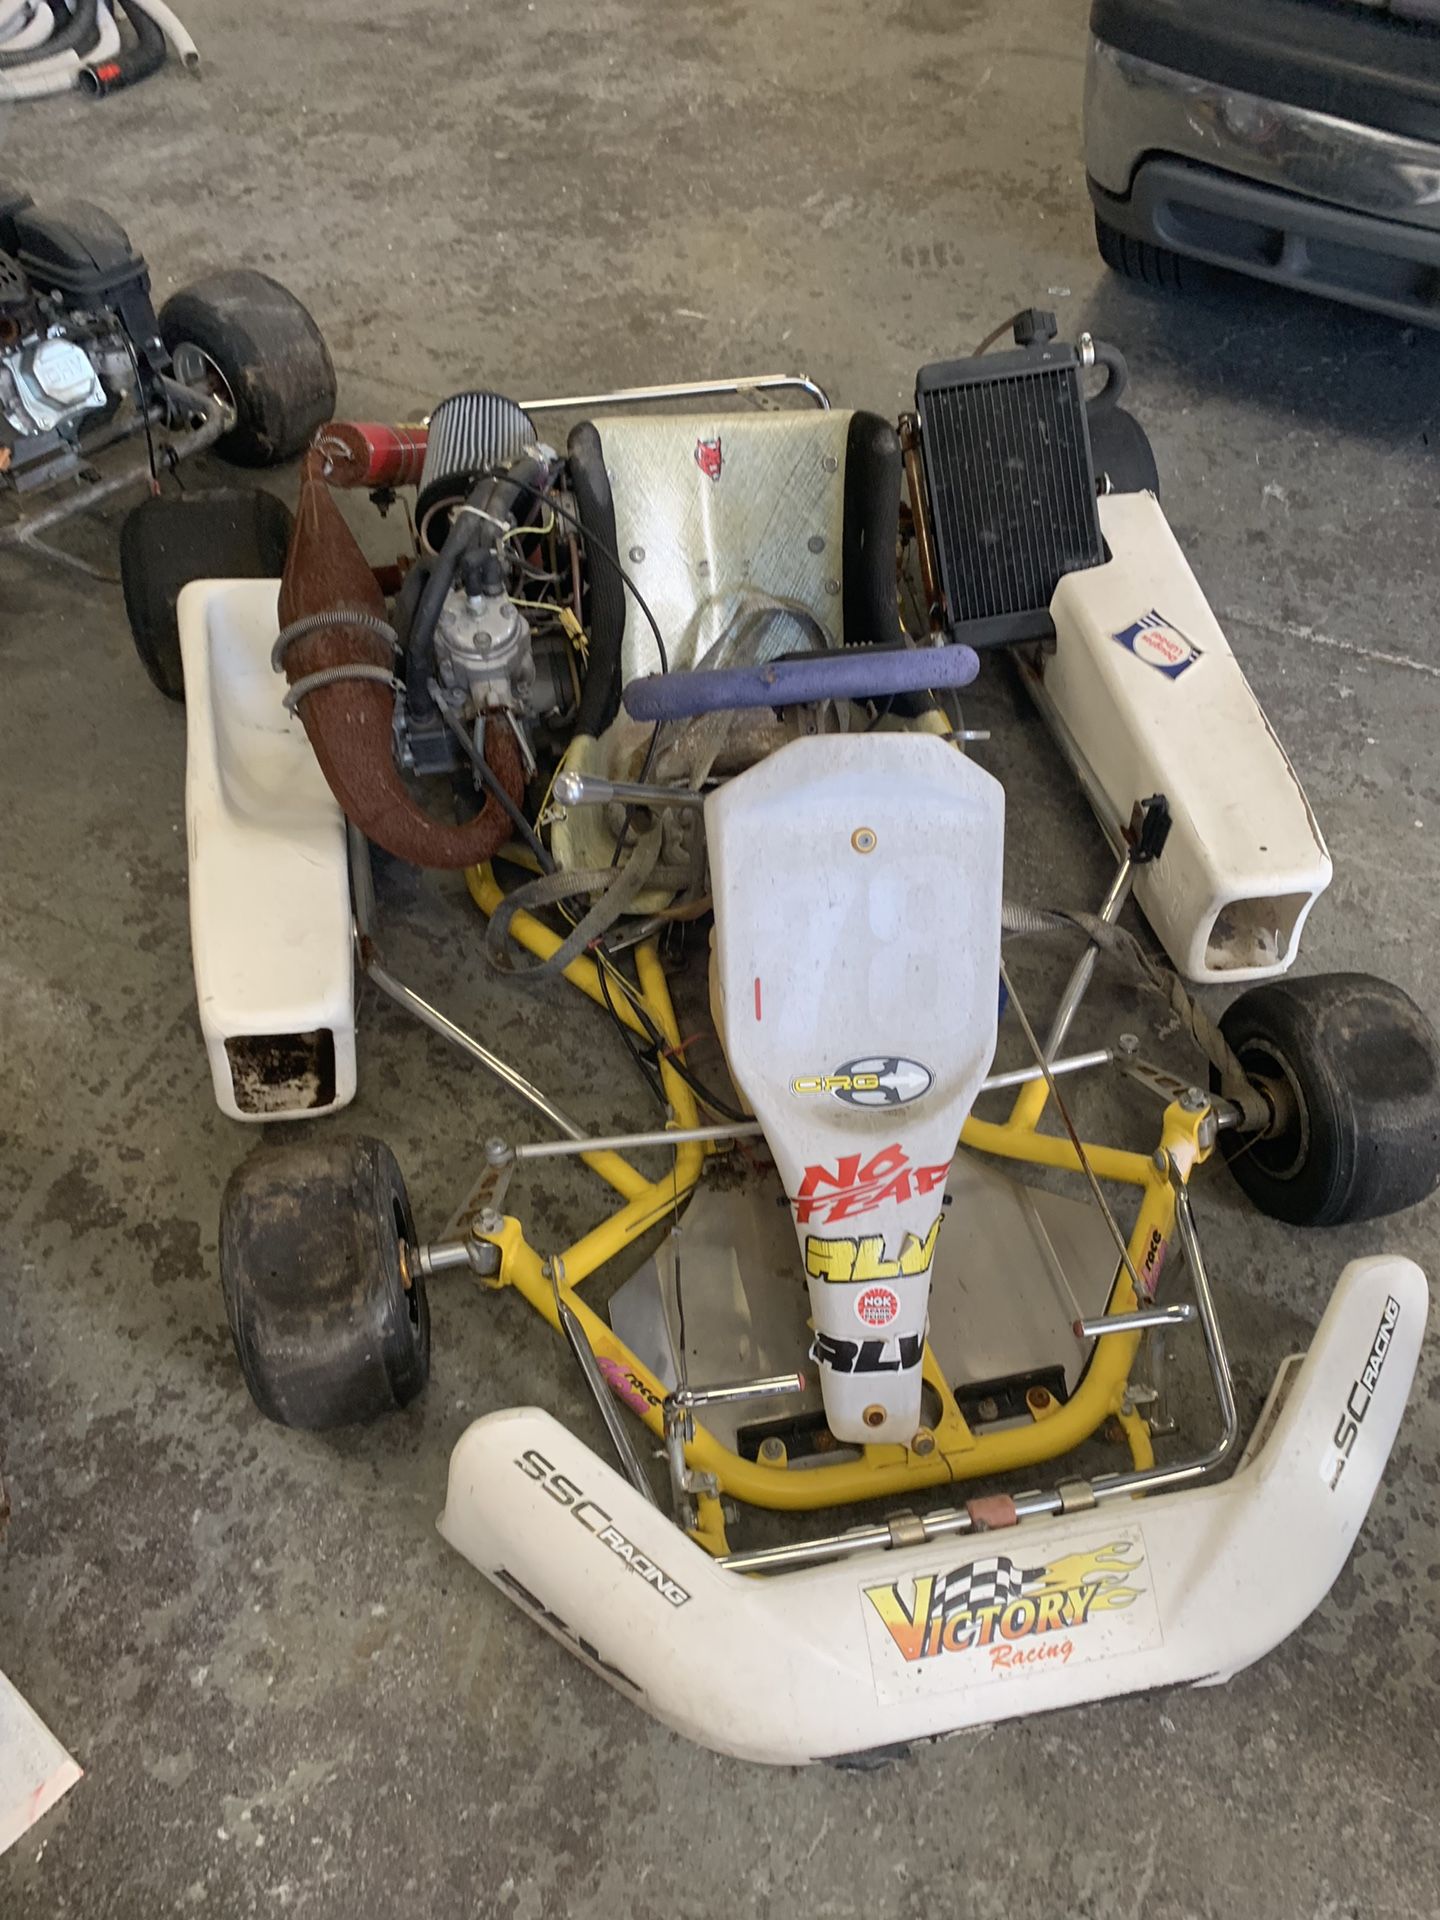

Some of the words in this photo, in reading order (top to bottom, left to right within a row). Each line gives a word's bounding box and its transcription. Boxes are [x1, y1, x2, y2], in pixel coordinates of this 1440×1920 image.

[795, 1073, 879, 1093] CRG
[798, 1142, 910, 1196] NO
[1145, 1229, 1162, 1272] race
[864, 1295, 891, 1308] NGK
[1362, 1296, 1400, 1392] RACING
[624, 1373, 662, 1407] race
[513, 1450, 613, 1533] SSC
[599, 1526, 691, 1607] RACING
[863, 1574, 1099, 1662] VICTORY
[989, 1636, 1075, 1671] Racing
